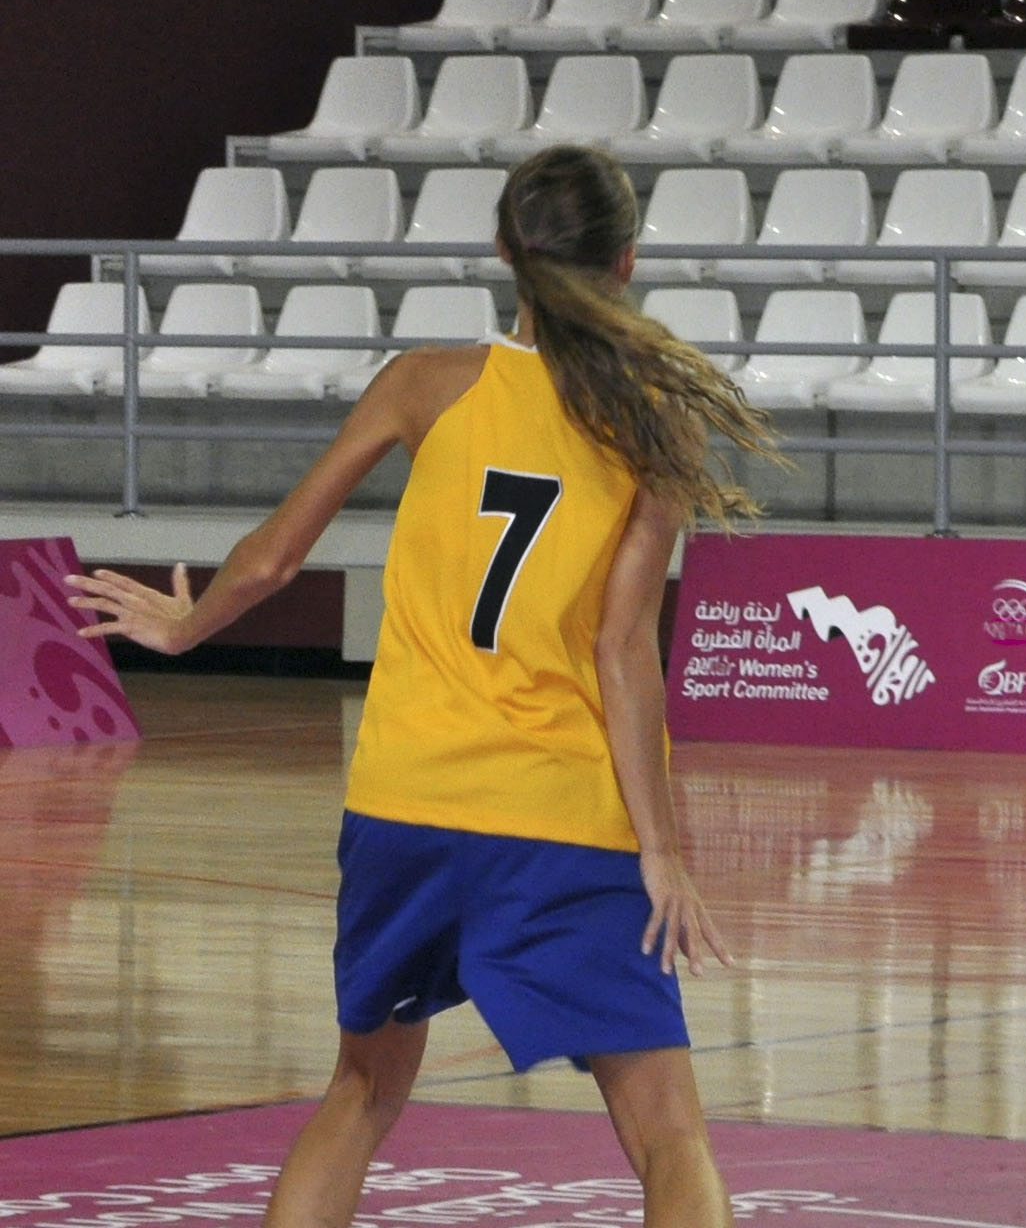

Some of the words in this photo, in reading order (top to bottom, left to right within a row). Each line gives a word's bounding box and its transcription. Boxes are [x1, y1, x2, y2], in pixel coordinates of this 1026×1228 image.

[469, 465, 564, 654] 7
[695, 601, 740, 625] رياضة
[743, 601, 781, 622] لجنة
[738, 658, 818, 679] Women's
[681, 678, 731, 701] Sport
[733, 679, 830, 701] Committee
